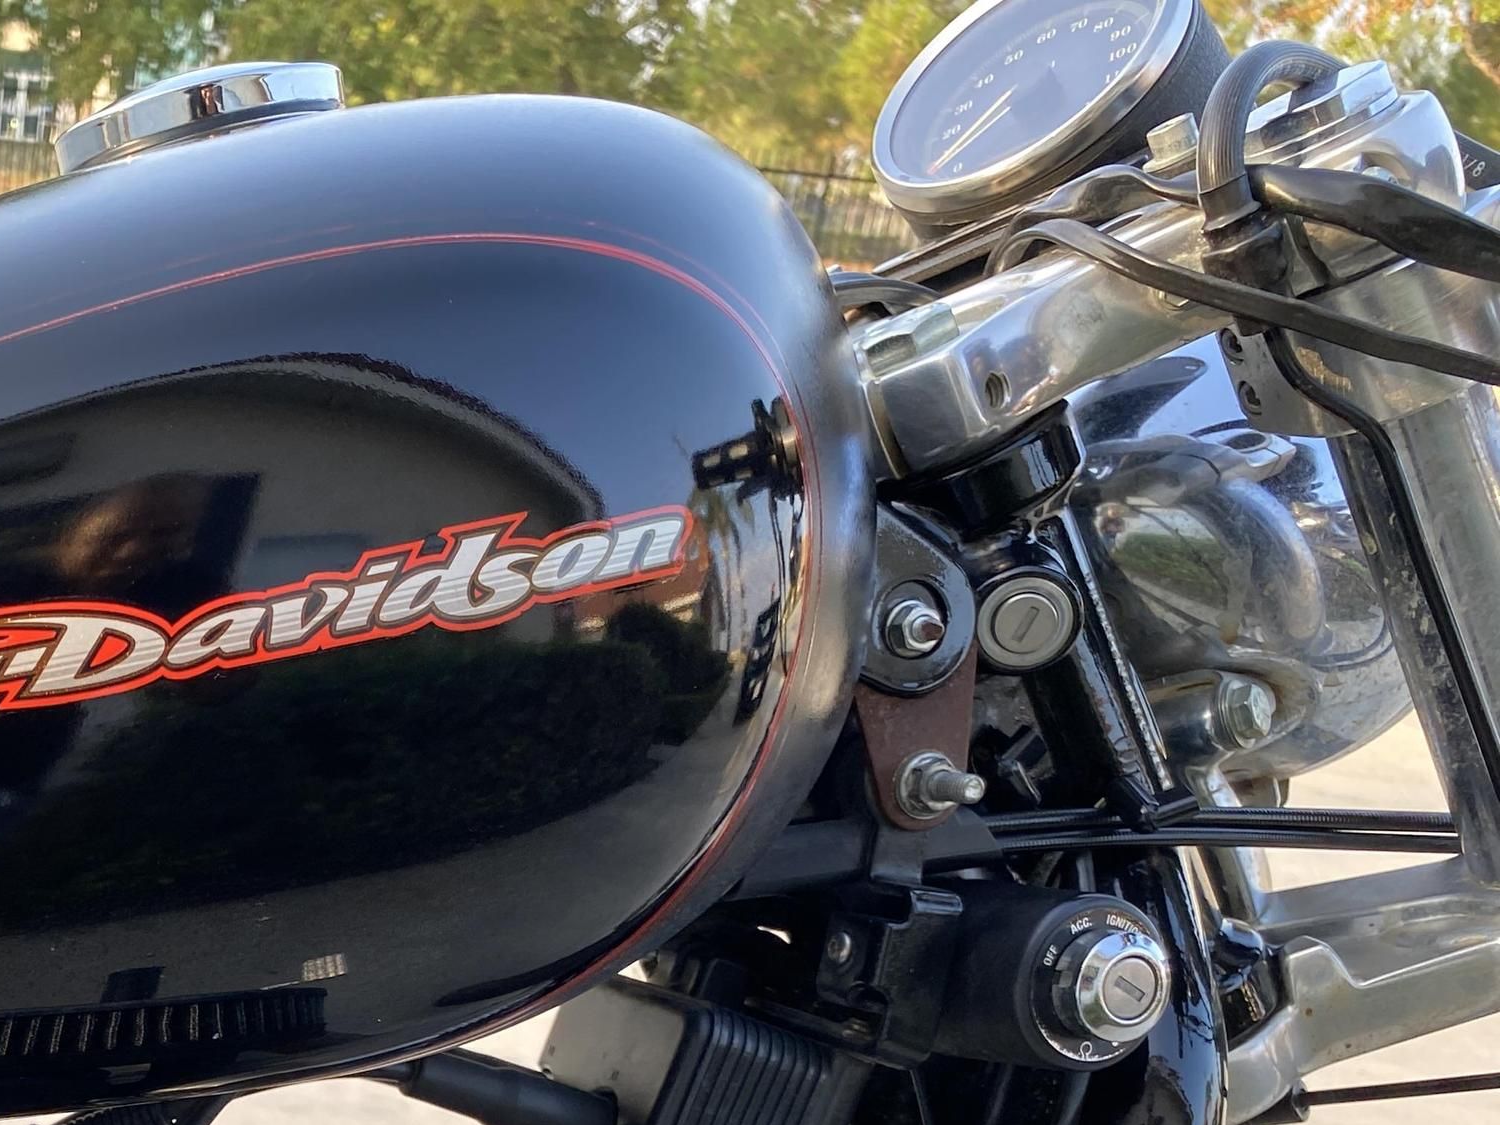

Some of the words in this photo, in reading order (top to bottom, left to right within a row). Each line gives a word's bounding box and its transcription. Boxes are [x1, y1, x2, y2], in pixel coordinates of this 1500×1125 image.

[1069, 18, 1088, 33] 70
[1110, 25, 1131, 41] 90
[1036, 28, 1056, 44] 60
[1004, 50, 1023, 65] 50
[1109, 42, 1137, 62] 100
[974, 73, 994, 88] 40
[954, 100, 973, 115] 30
[1070, 917, 1093, 935] ACC.
[1106, 914, 1139, 933] IGNITIO
[1043, 944, 1058, 967] OFF
